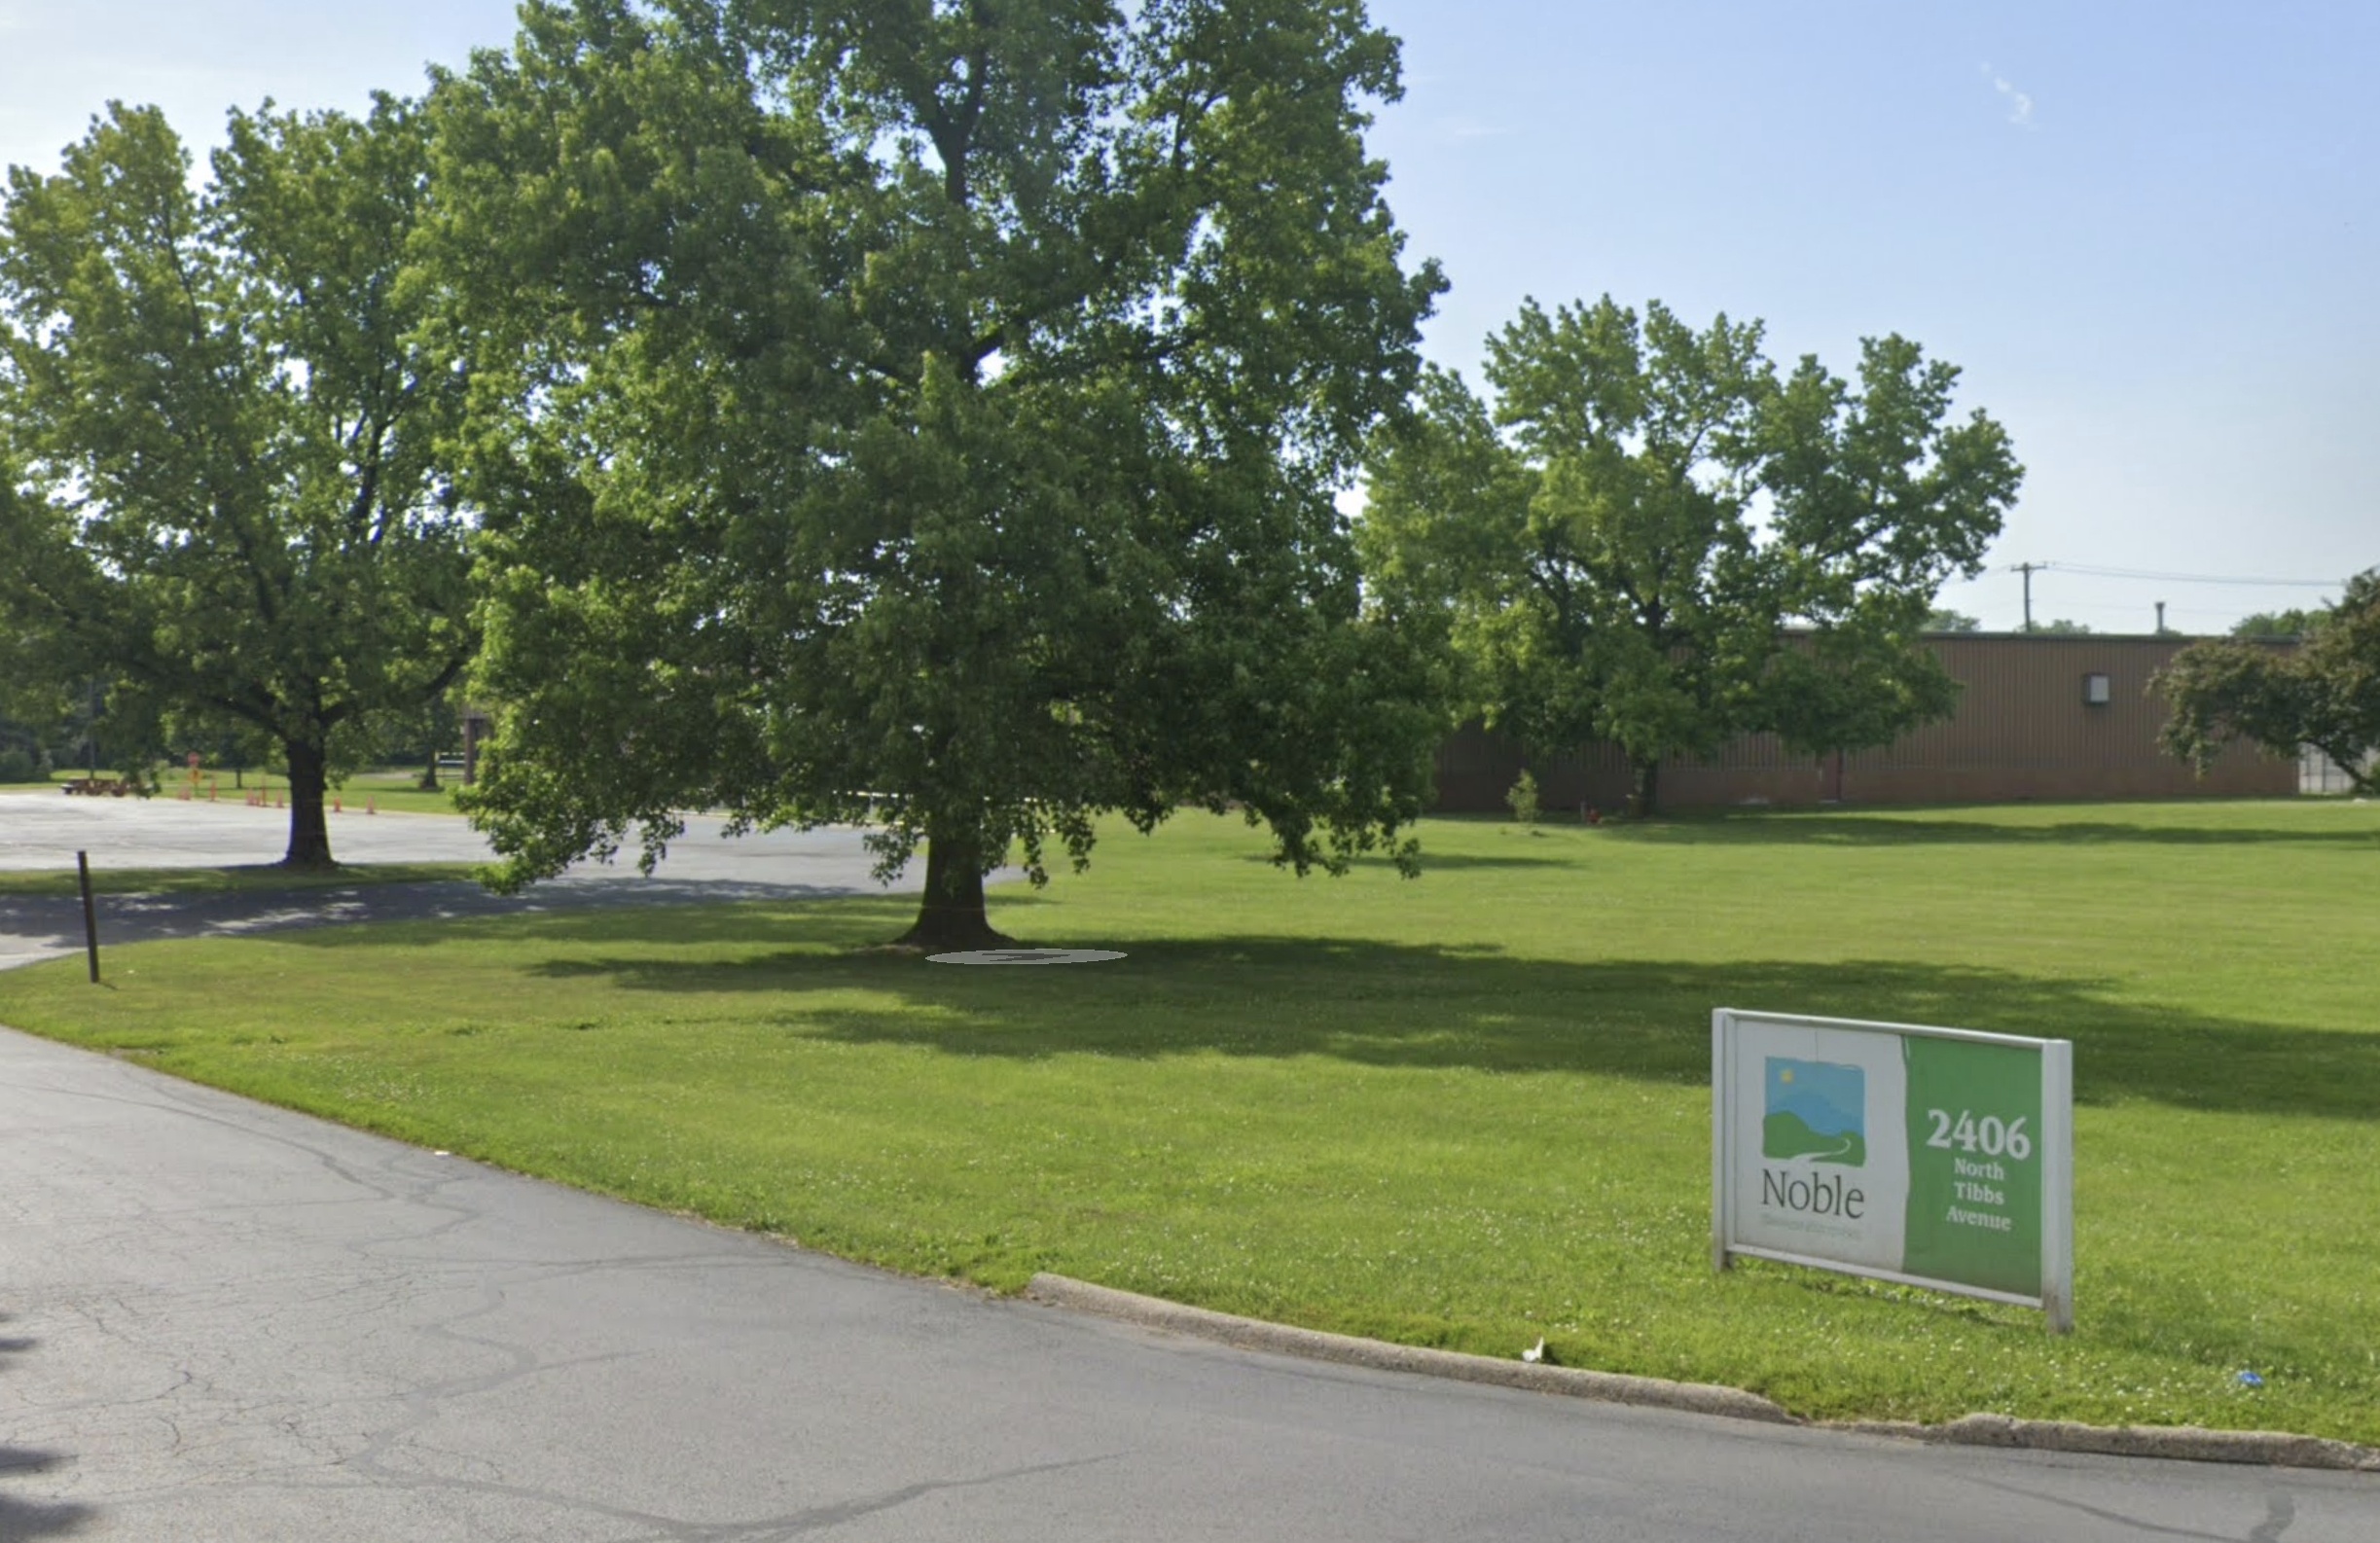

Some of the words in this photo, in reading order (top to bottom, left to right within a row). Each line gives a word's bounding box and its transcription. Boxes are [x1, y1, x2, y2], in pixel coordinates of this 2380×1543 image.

[1927, 1108, 2031, 1161] 2406
[1954, 1157, 2004, 1181] North
[1761, 1168, 1865, 1219] Noble
[1953, 1181, 2004, 1205] Tibbs
[1946, 1205, 2012, 1232] Avenue
